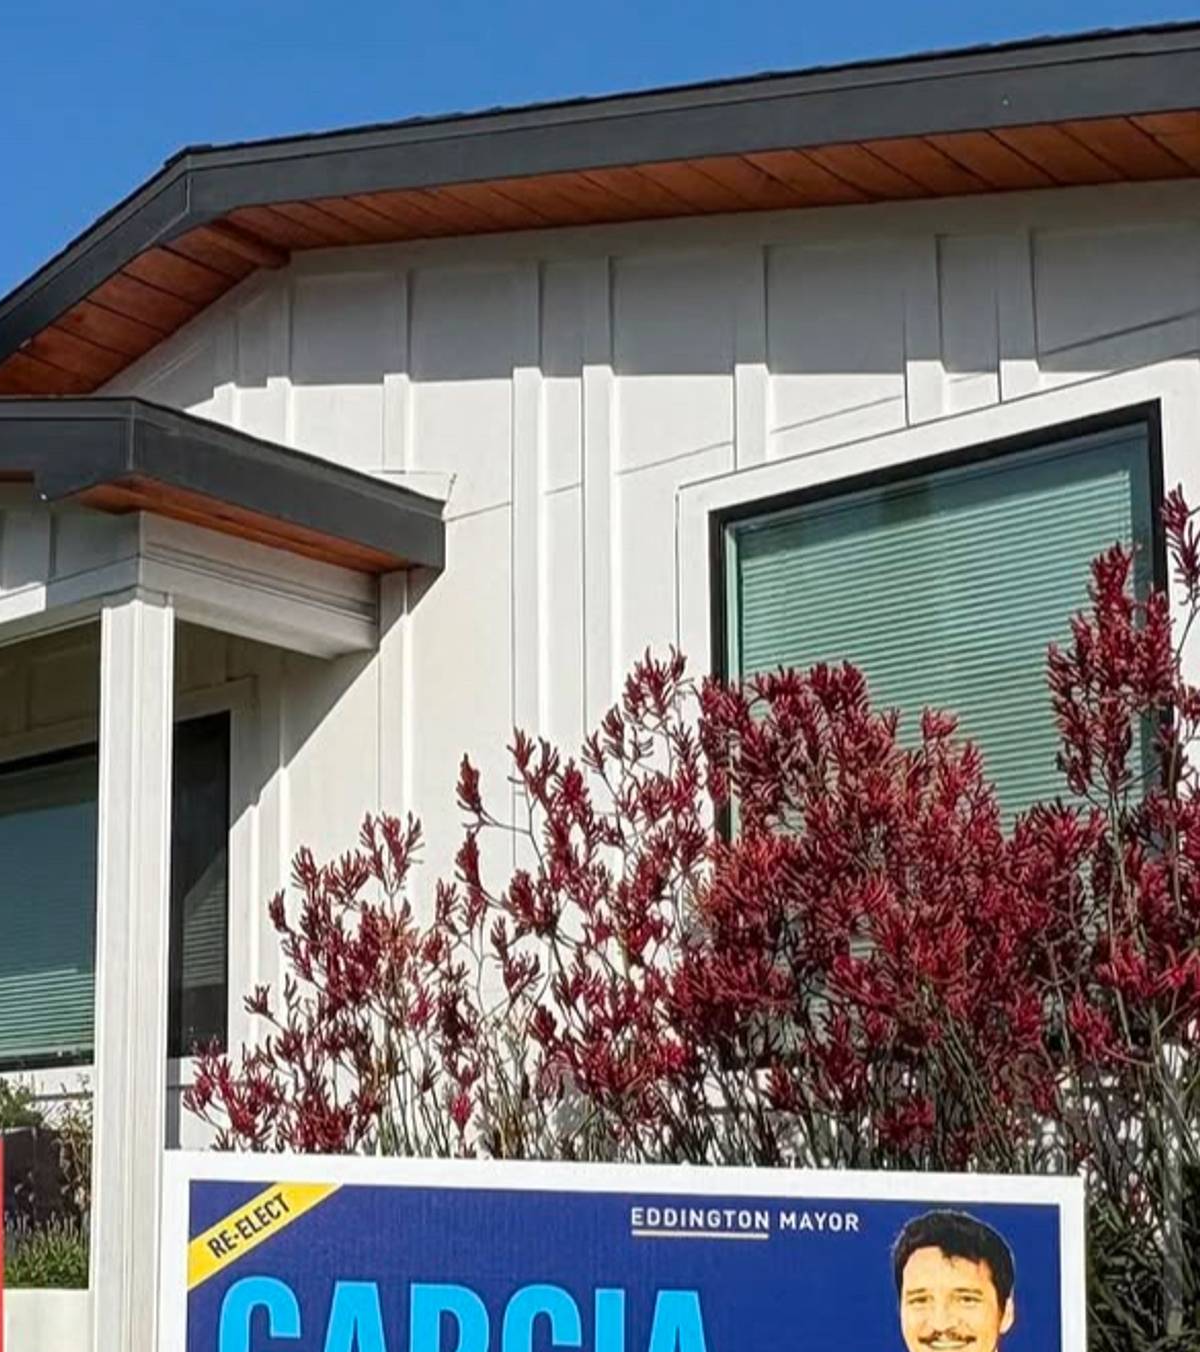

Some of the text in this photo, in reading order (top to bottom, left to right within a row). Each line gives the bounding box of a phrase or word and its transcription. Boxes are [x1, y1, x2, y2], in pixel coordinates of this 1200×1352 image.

[206, 1191, 290, 1259] RE-ELECT
[631, 1206, 860, 1232] EDDINGTON MAYOR
